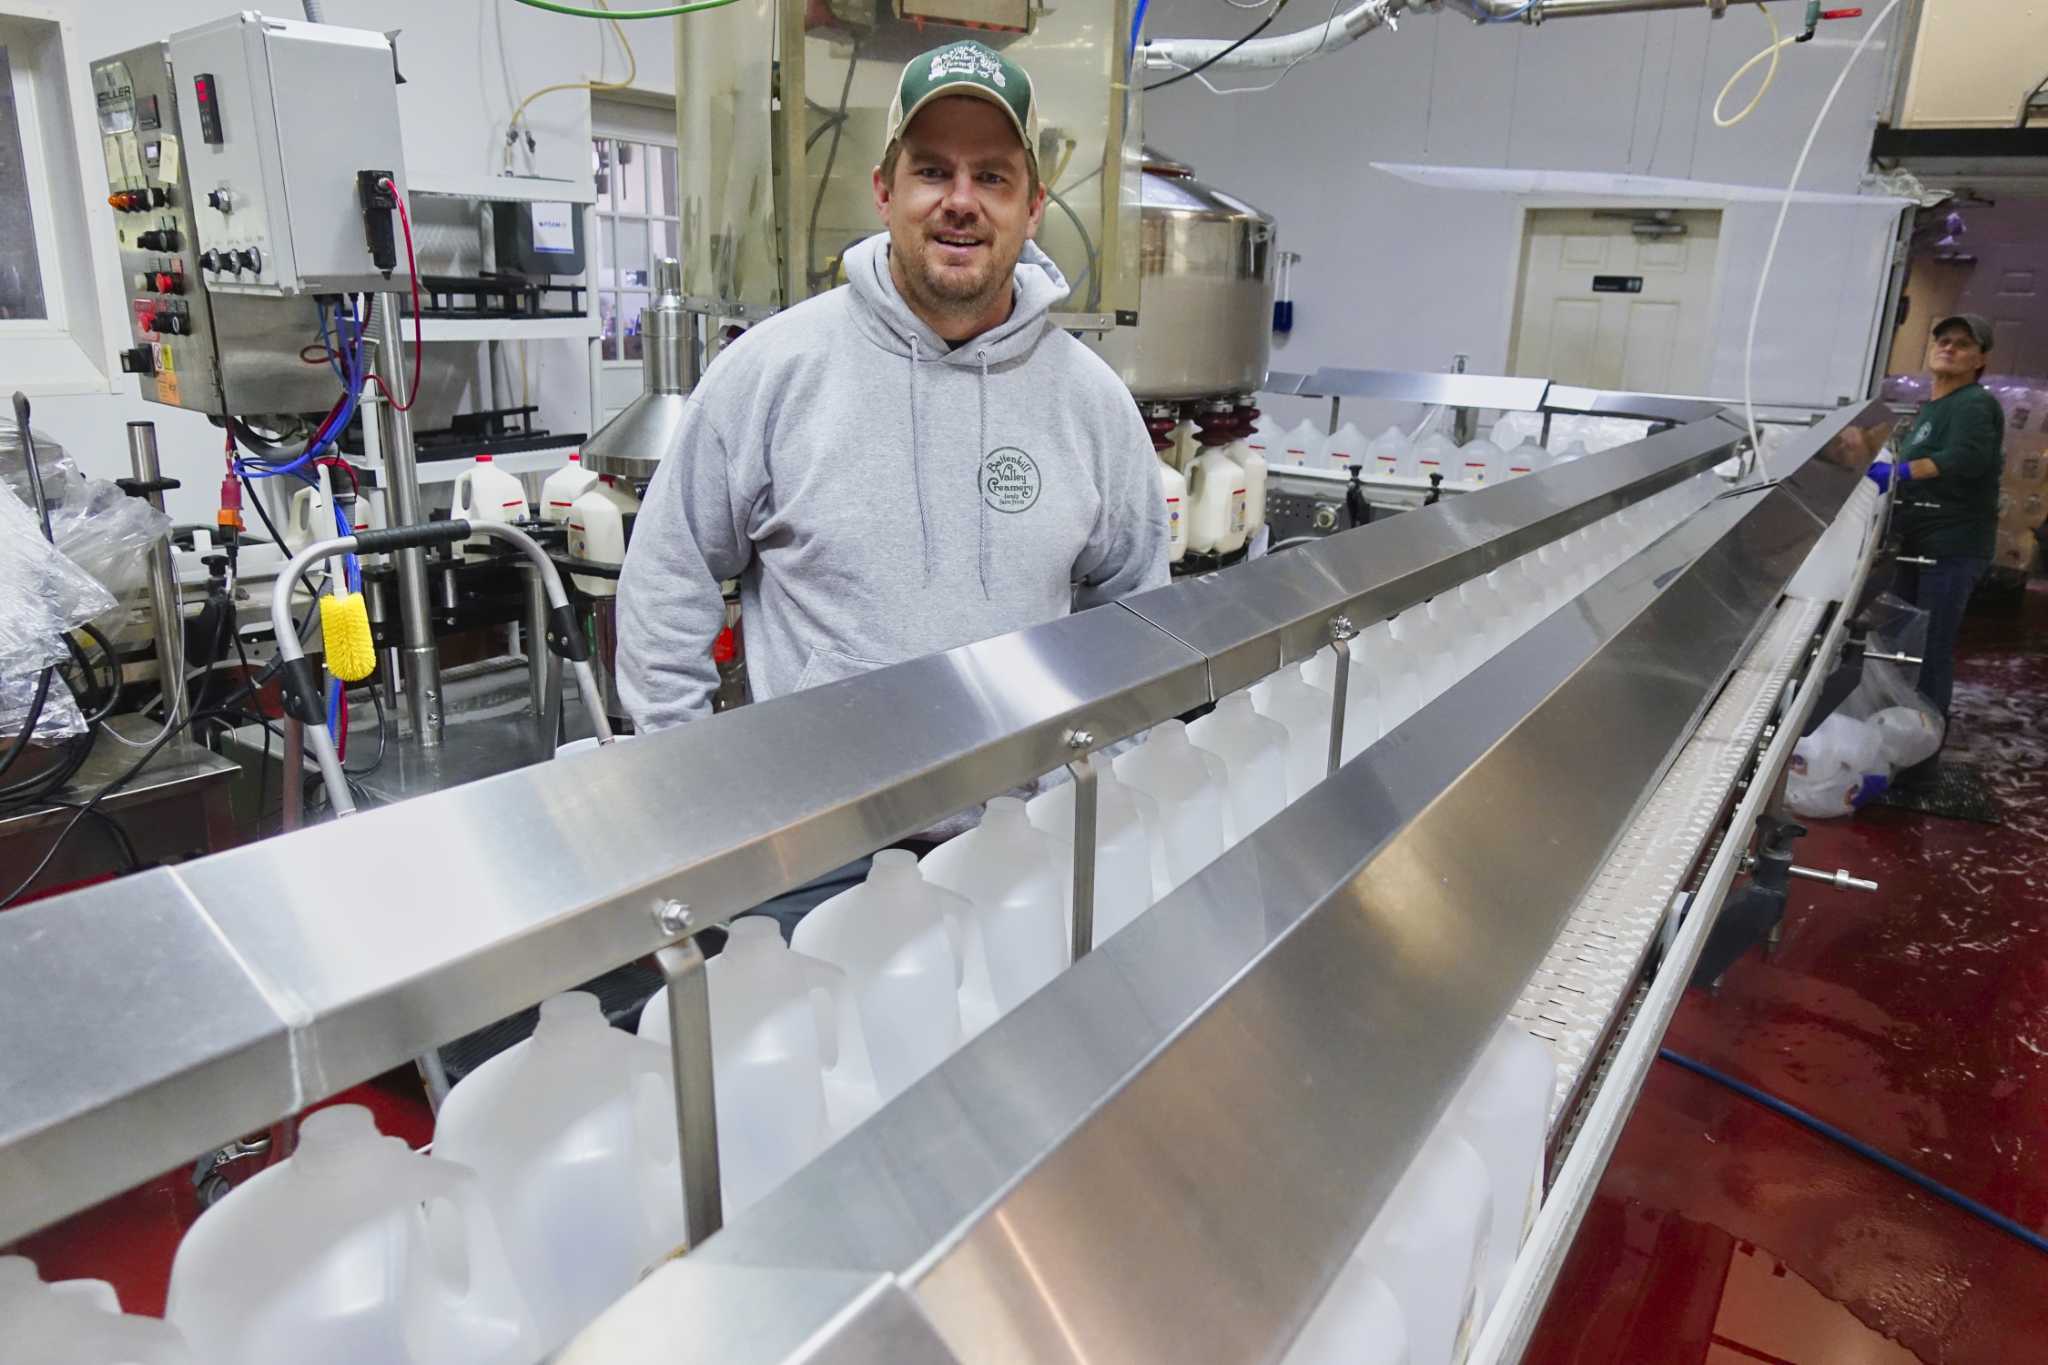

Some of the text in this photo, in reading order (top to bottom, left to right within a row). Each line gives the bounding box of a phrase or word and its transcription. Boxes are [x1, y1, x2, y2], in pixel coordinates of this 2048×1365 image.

[986, 455, 1032, 473] Battenkill
[996, 464, 1026, 484] Valley
[988, 477, 1033, 498] Creamery
